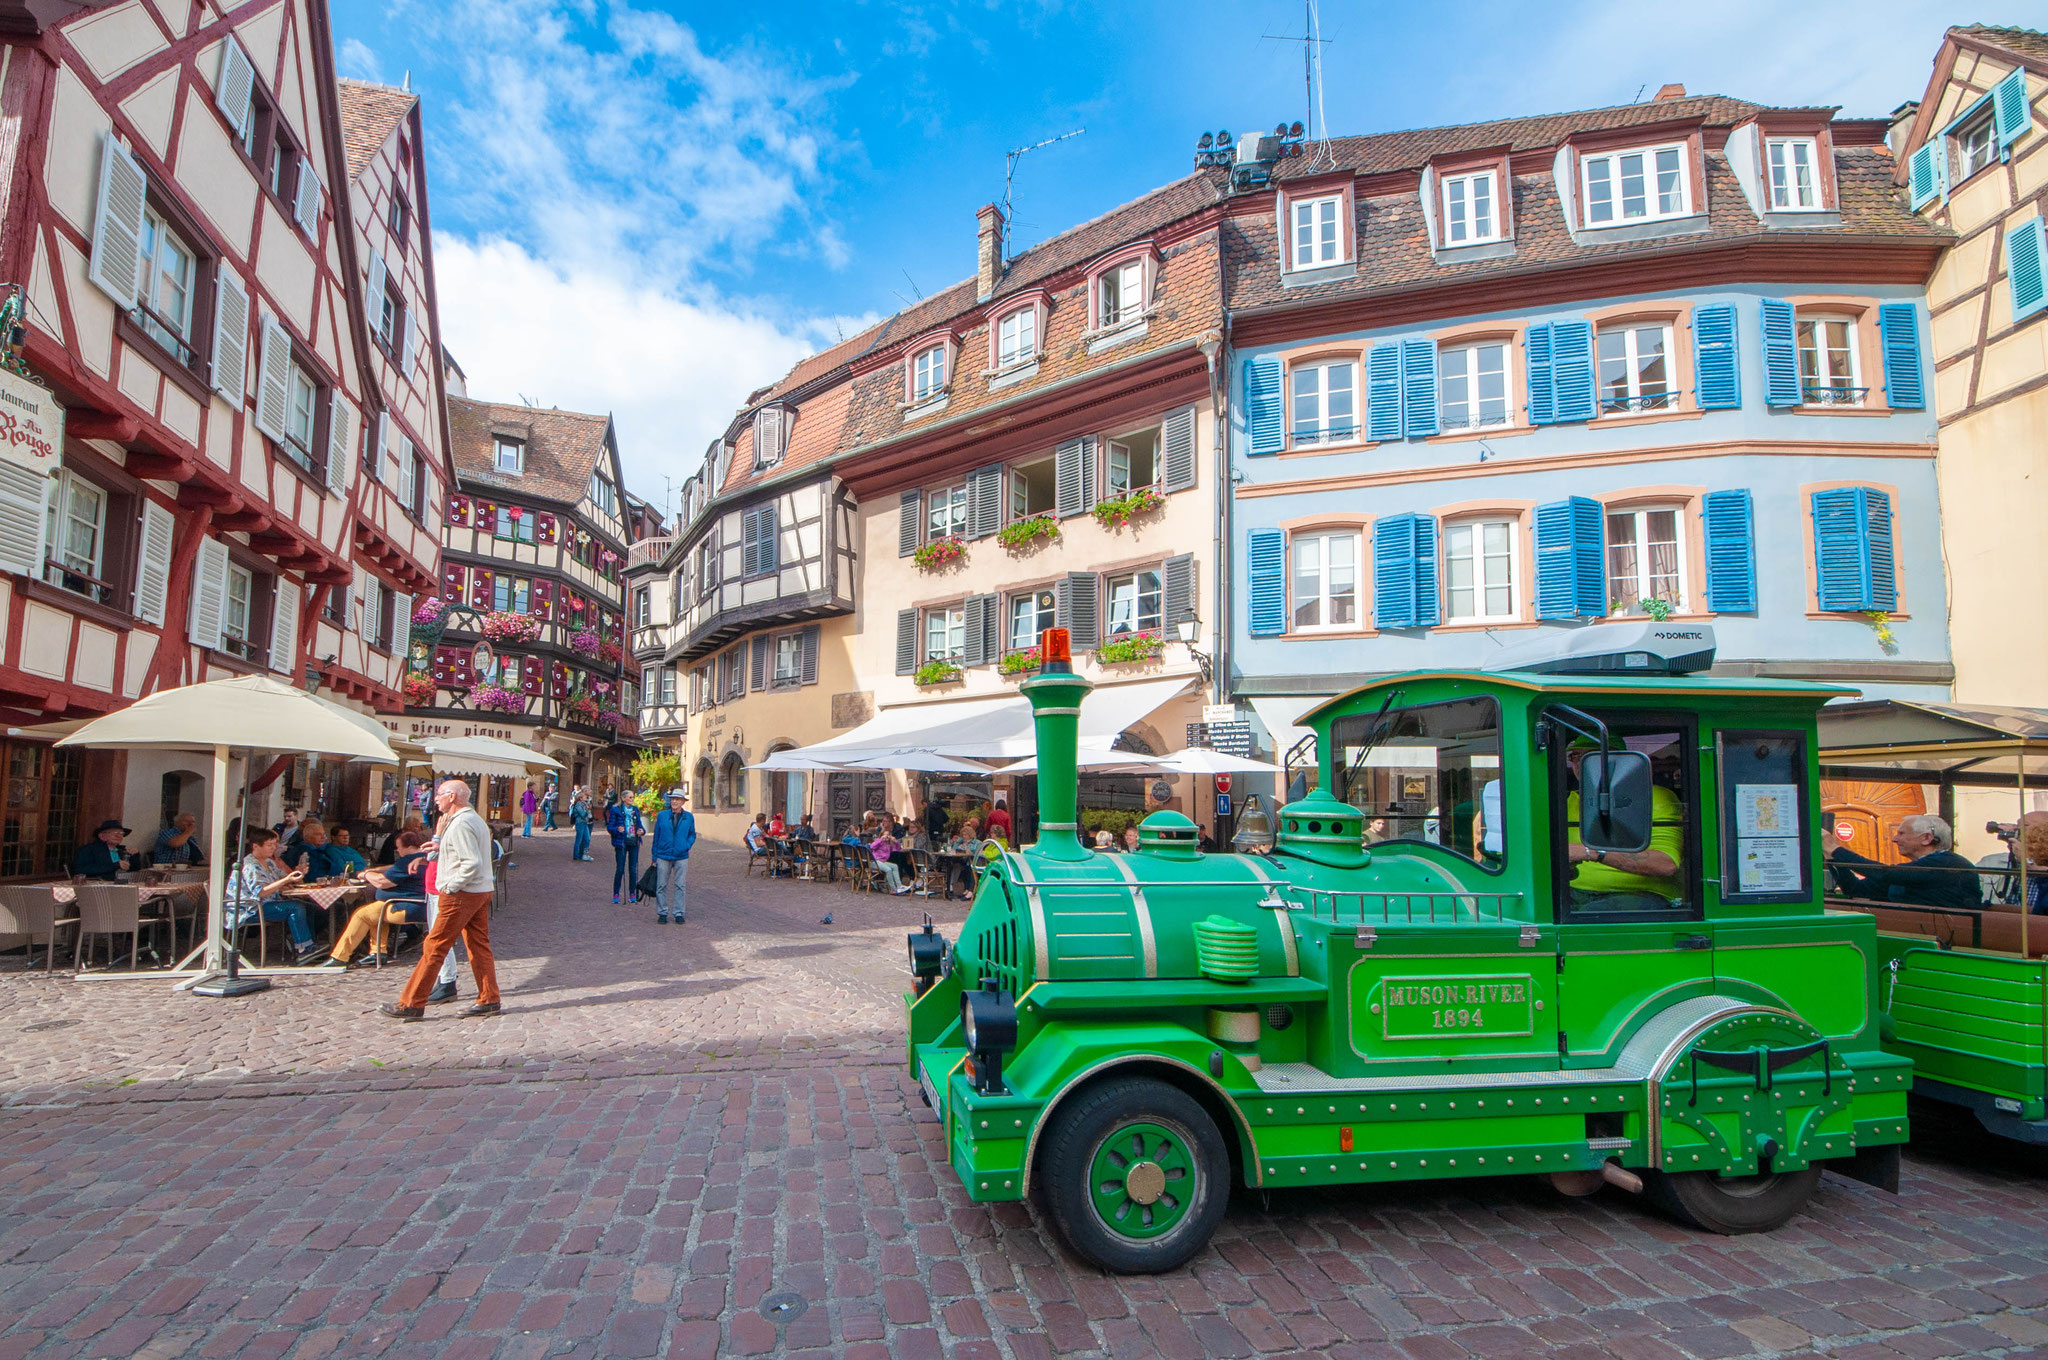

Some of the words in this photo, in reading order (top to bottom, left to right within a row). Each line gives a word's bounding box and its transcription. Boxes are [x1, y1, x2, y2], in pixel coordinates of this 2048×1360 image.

[0, 389, 39, 415] taurant
[1665, 632, 1702, 640] DOMETIC
[1432, 1008, 1483, 1028] 1894
